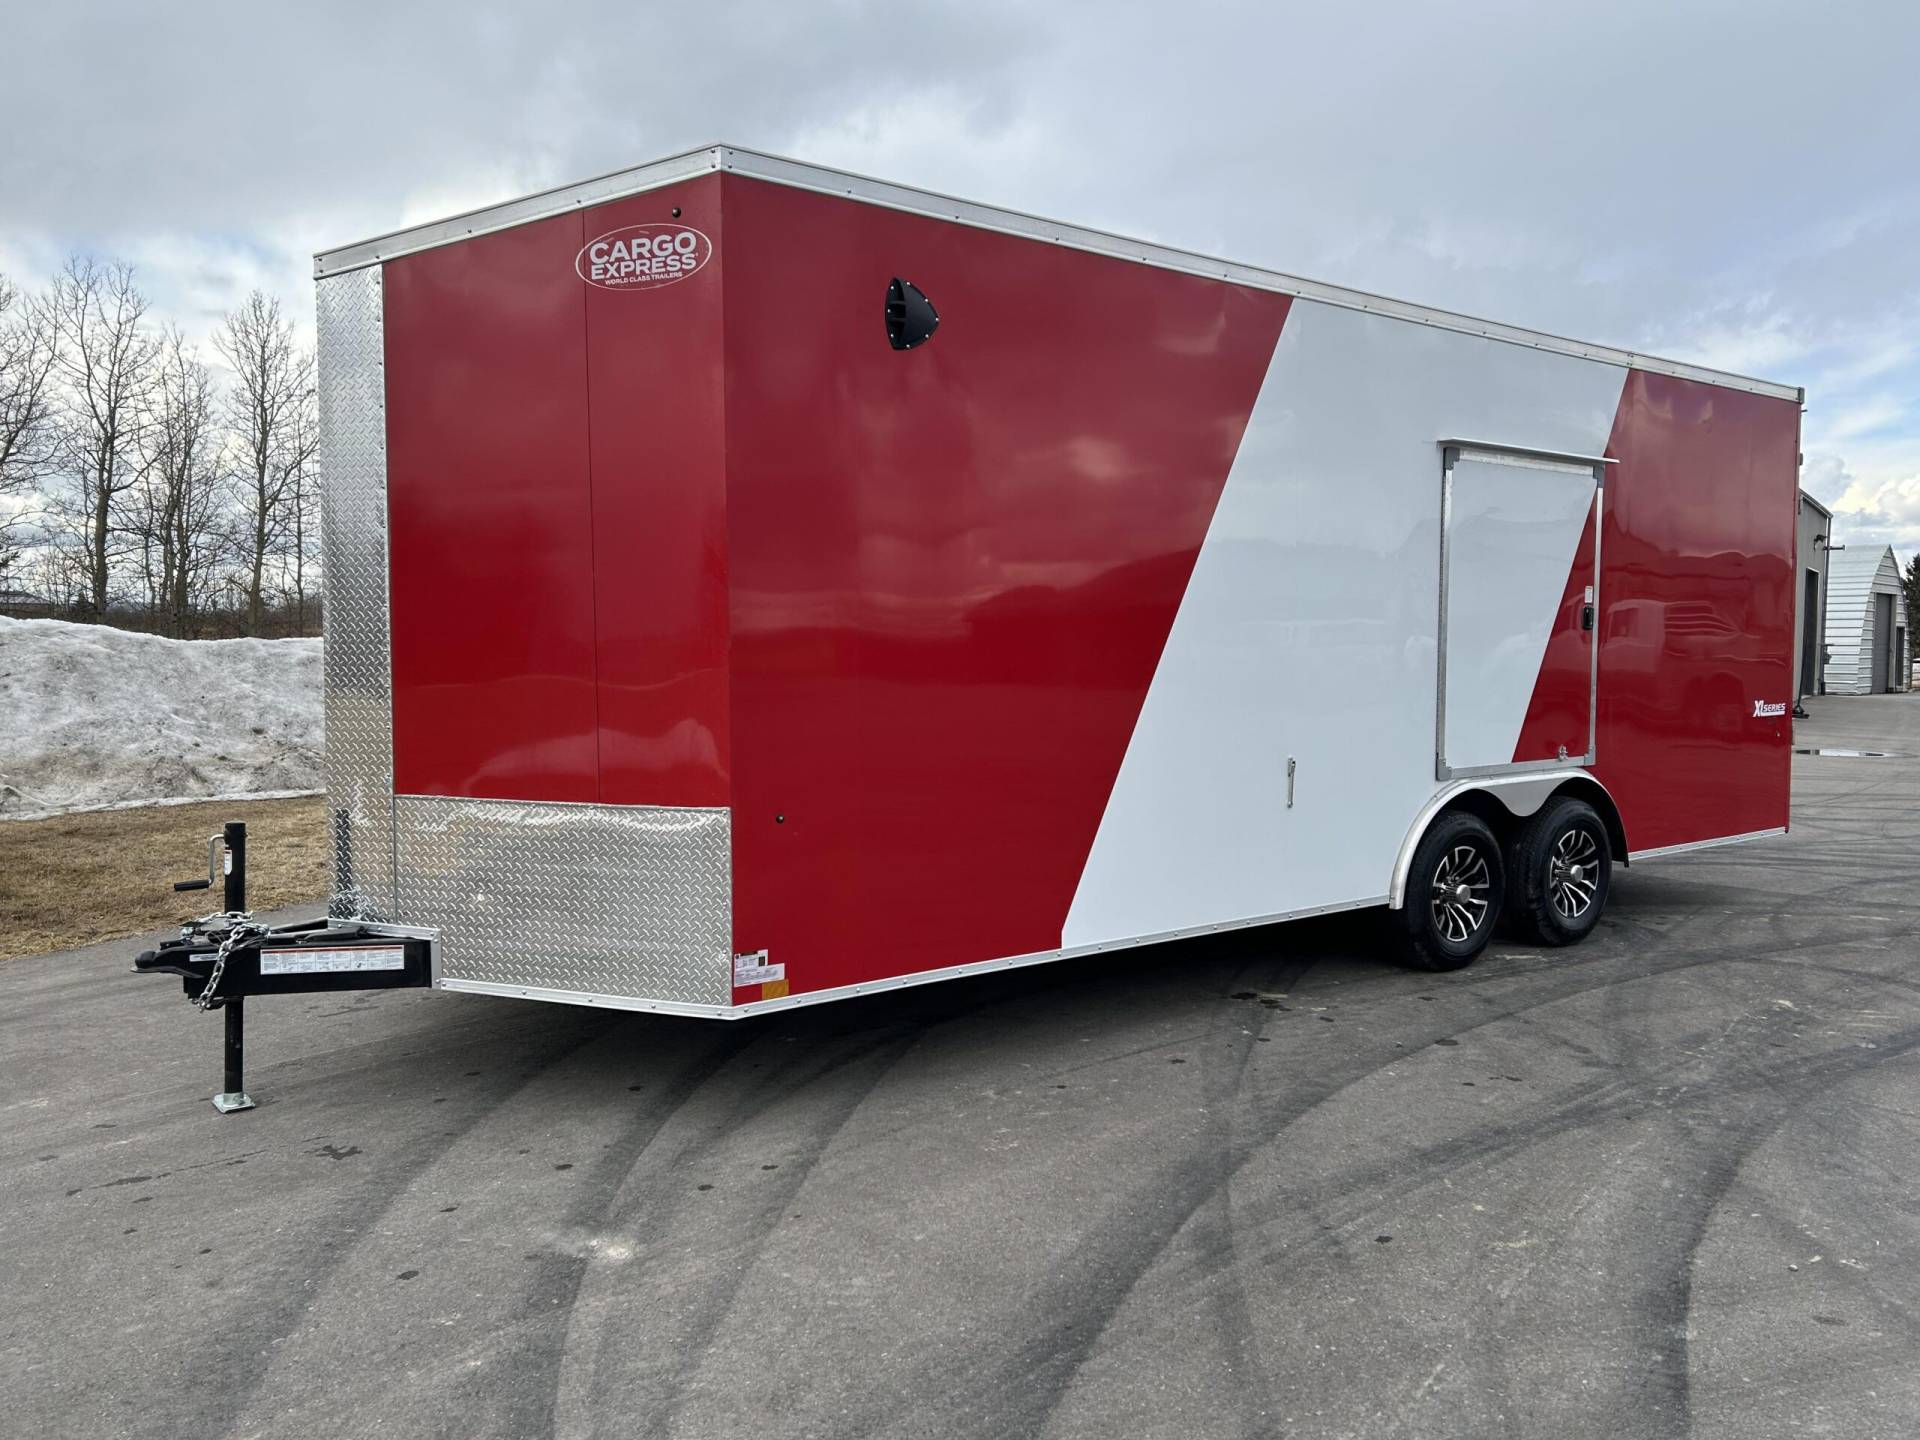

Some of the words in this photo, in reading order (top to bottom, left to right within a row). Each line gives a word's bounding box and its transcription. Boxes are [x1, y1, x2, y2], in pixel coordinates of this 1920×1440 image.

[590, 231, 697, 264] CARGO
[591, 253, 697, 280] EXPRESS
[605, 277, 628, 285] WORLD
[629, 275, 651, 283] CLASS
[651, 271, 683, 280] TRAILERS
